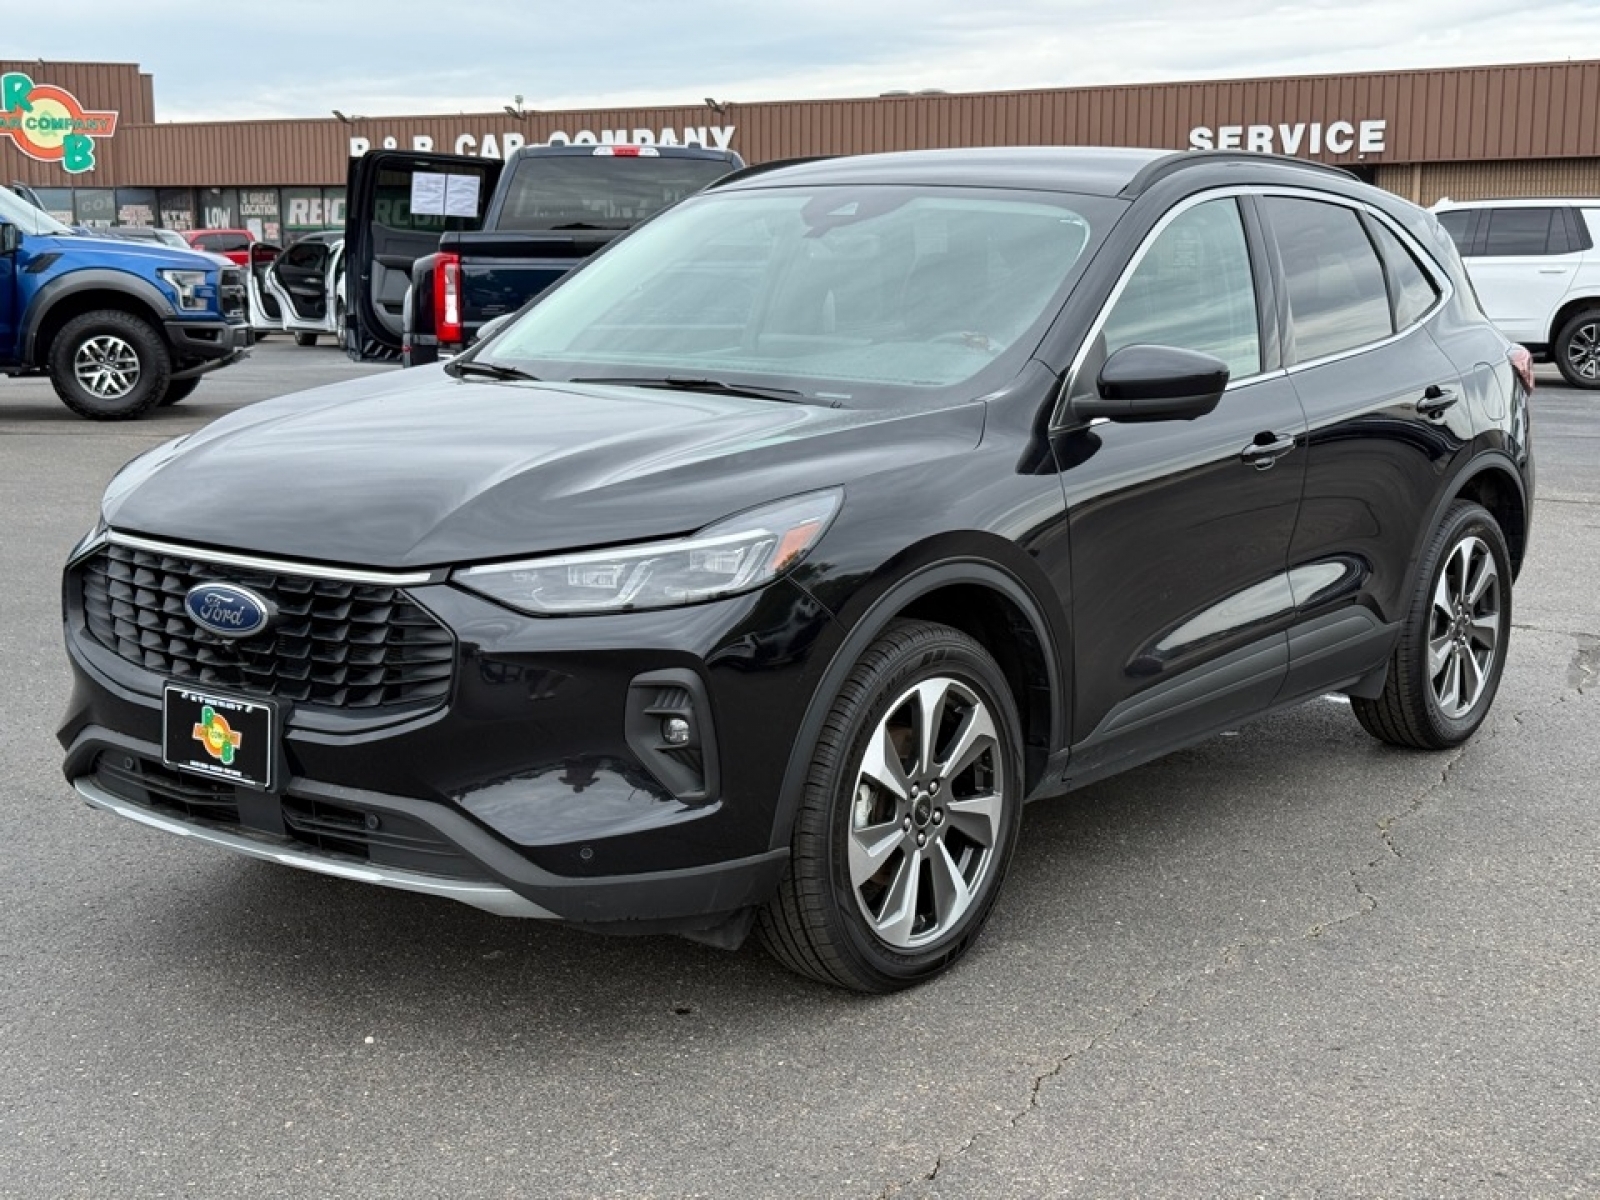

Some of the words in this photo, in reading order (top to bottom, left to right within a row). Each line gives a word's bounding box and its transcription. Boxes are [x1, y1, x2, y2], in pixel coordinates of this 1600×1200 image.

[1, 72, 34, 113] R
[62, 134, 95, 173] B
[25, 117, 111, 130] COMPANY
[1189, 119, 1387, 154] SERVICE
[200, 593, 245, 625] Ford
